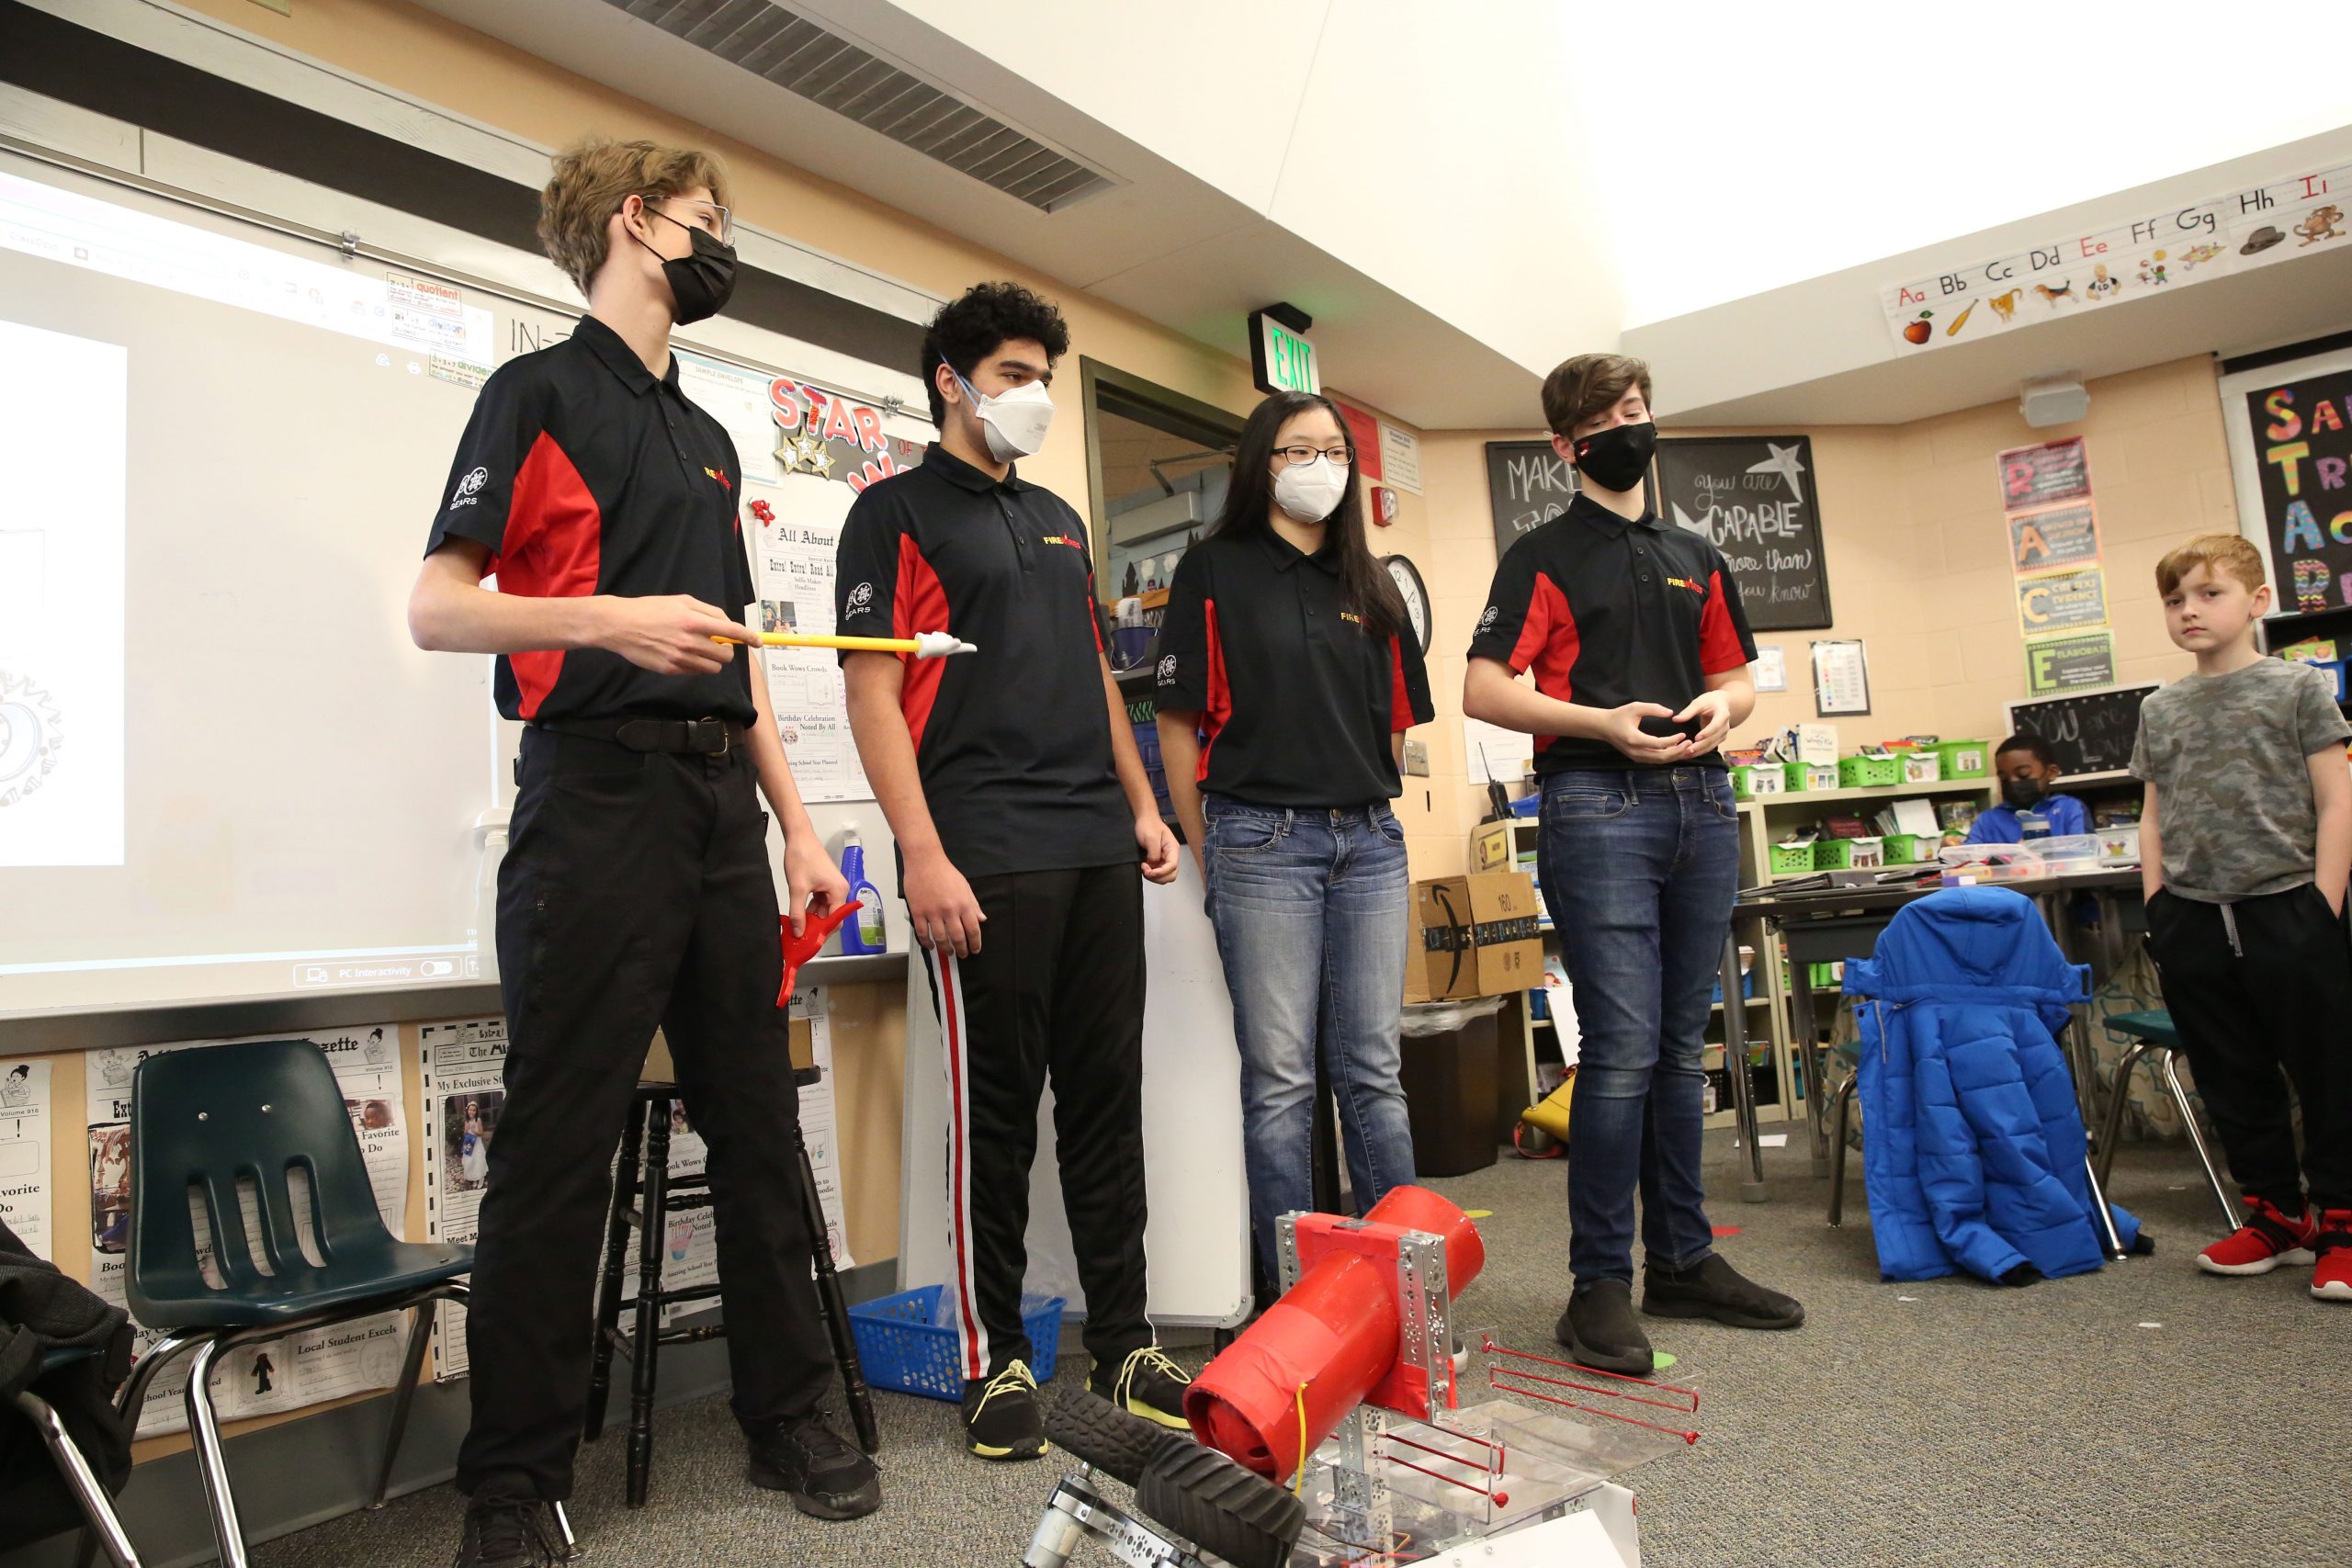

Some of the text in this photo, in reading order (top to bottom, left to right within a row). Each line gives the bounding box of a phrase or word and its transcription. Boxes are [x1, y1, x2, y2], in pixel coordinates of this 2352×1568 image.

[1899, 175, 2327, 307] Aa Bb Cc Dd Ee Ff Gg Hh Ii
[416, 282, 459, 300] quotient
[428, 317, 462, 333] divisor
[1272, 326, 1313, 393] EXIT
[458, 360, 492, 377] dividen
[768, 378, 888, 454] STAR
[898, 440, 914, 456] OF
[1508, 455, 1583, 502] MAKE
[1742, 473, 1781, 491] are
[2007, 462, 2034, 497] R
[449, 497, 478, 511] GEARS
[1709, 500, 1804, 547] CAPABLE
[778, 527, 834, 547] All About
[2018, 525, 2052, 561] A
[770, 558, 787, 572] Extra!
[790, 561, 807, 574] Extra!
[1765, 548, 1812, 572] than
[1768, 575, 1816, 604] know
[845, 606, 871, 621] GEARS
[2022, 588, 2051, 623] C
[807, 665, 828, 673] Crowds
[2032, 649, 2057, 689] E
[777, 715, 802, 723] Birthday
[2025, 709, 2079, 743] YOU
[819, 724, 826, 733] By
[339, 965, 412, 978] PC Interactivity
[318, 1036, 359, 1054] zette
[469, 1046, 488, 1058] The
[437, 1075, 503, 1093] My Exclusive St
[0, 1109, 26, 1117] Volume
[113, 1100, 131, 1119] Ext
[361, 1129, 400, 1140] Favorite
[368, 1144, 383, 1153] Do
[668, 1159, 701, 1171] ook Wows
[0, 1184, 40, 1197] vorite
[818, 1186, 835, 1195] oodie
[668, 1215, 695, 1228] Birthday
[692, 1220, 712, 1232] Noted
[826, 1219, 837, 1228] cels
[447, 1235, 468, 1244] Meet
[101, 1262, 125, 1273] Boo
[298, 1325, 397, 1355] Local Student Excels
